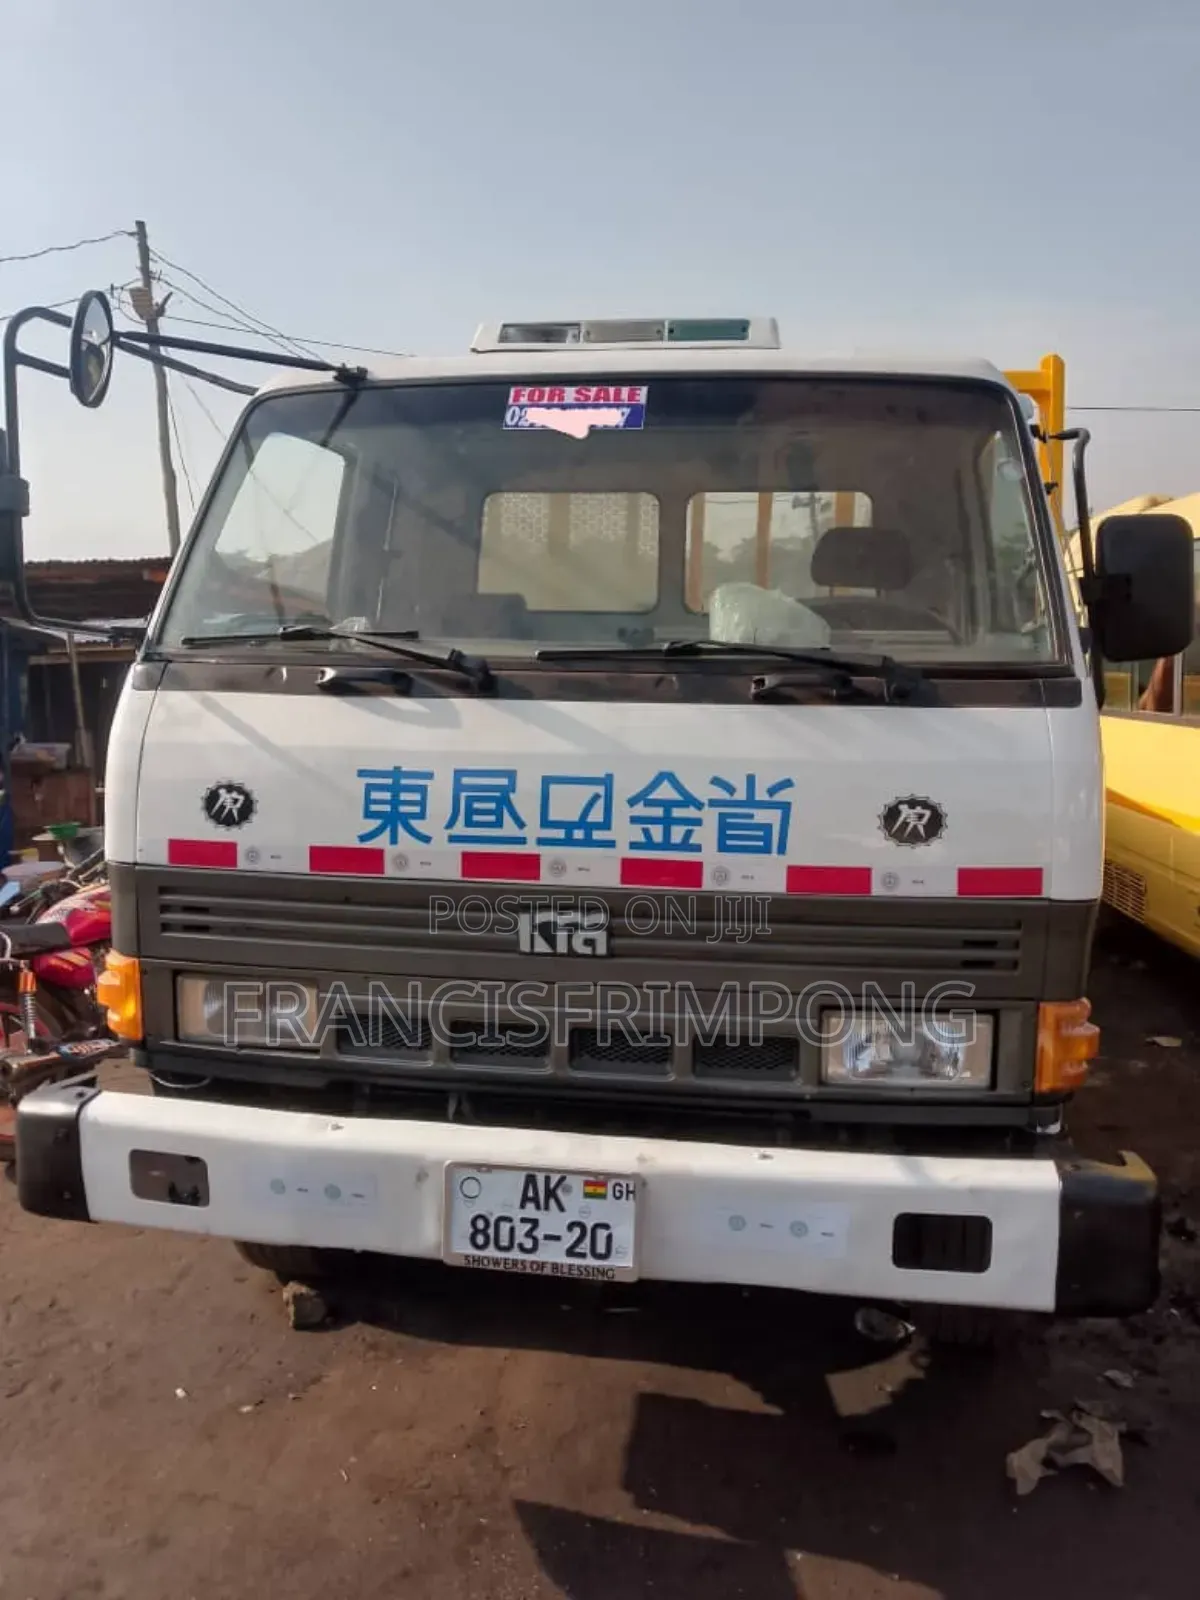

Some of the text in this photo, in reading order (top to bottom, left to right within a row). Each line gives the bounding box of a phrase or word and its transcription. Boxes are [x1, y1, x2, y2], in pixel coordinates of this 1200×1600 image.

[511, 386, 642, 403] FOR SALE
[518, 1173, 636, 1213] AK GH
[468, 1213, 614, 1261] 803-20
[463, 1254, 616, 1280] SHOWERS OF BLESSING
